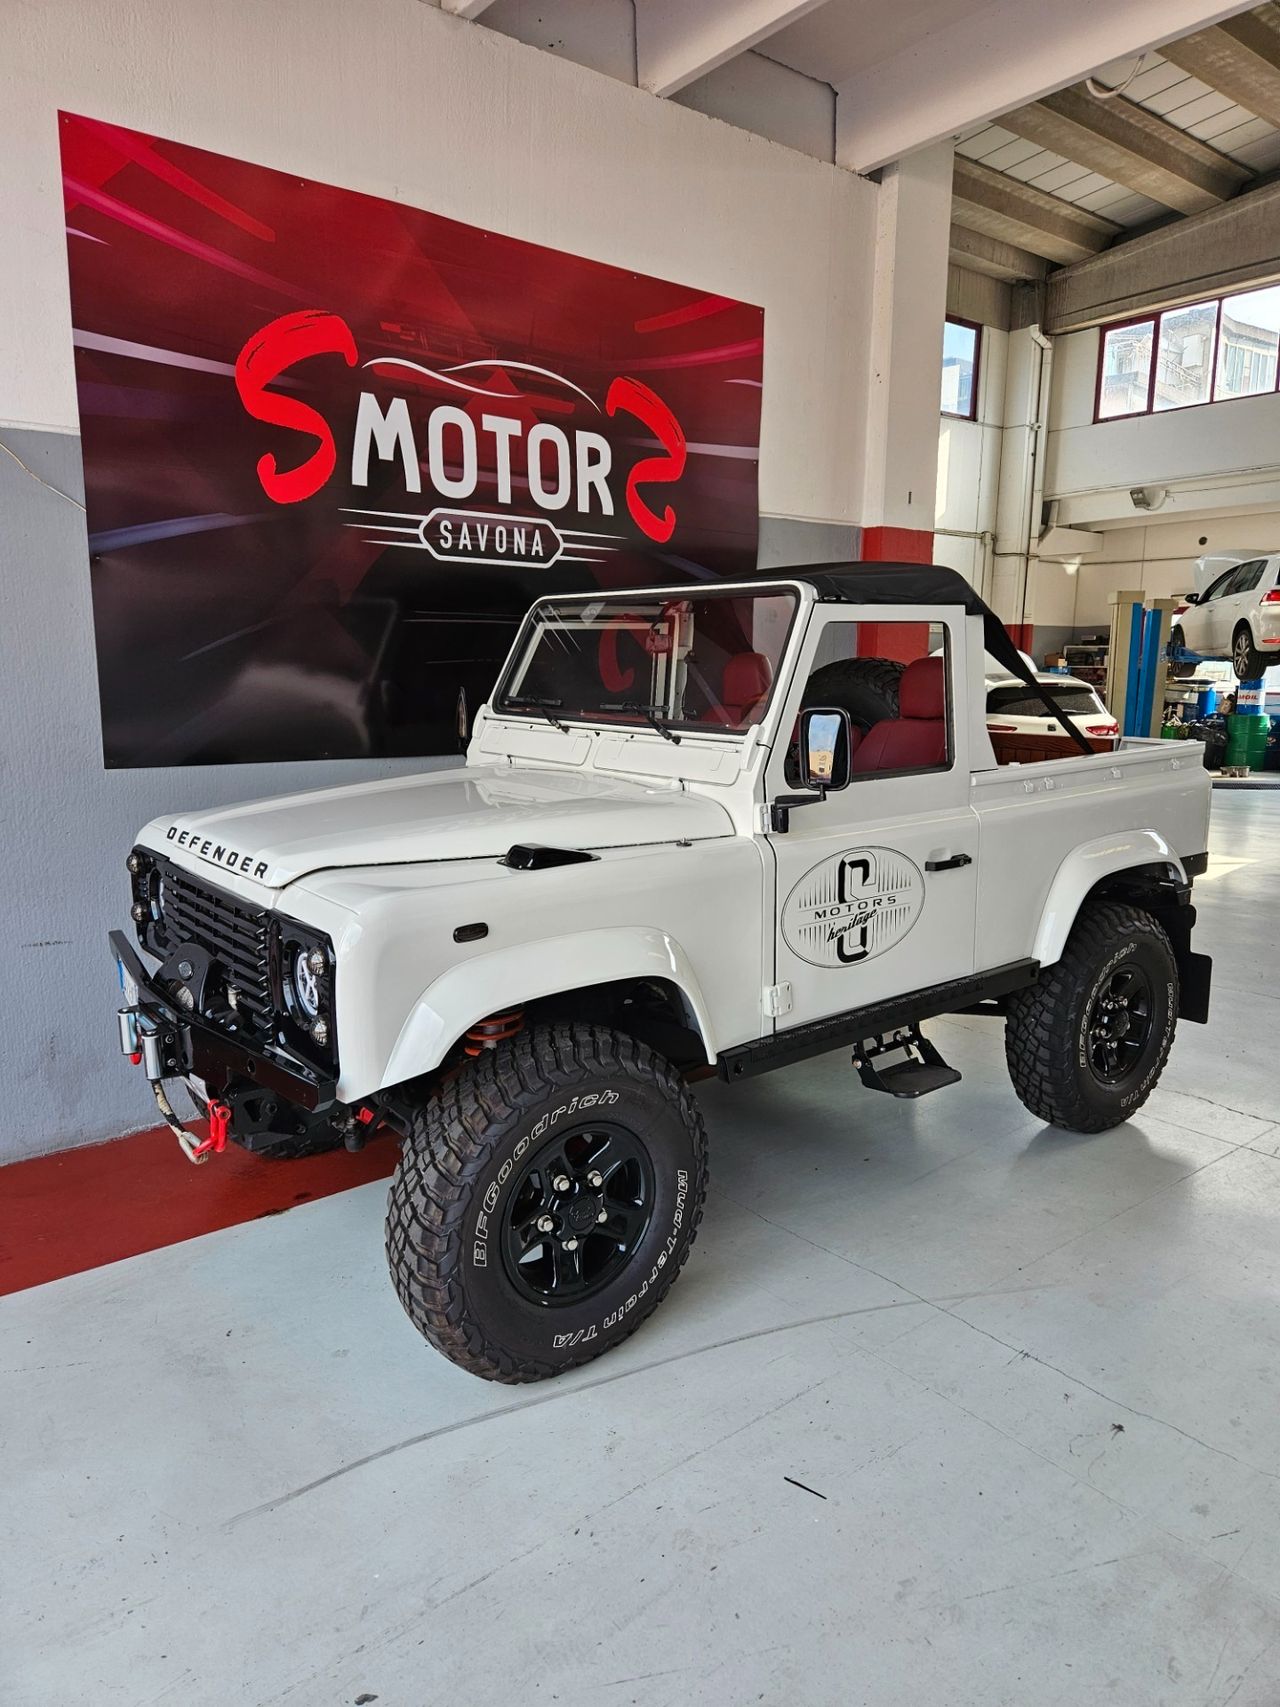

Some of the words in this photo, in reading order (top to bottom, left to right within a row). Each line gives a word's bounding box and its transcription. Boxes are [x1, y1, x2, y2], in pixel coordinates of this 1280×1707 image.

[439, 519, 545, 557] SAVONA
[166, 826, 269, 879] DEFENDER
[814, 895, 897, 920] MOTORS
[826, 908, 878, 943] heritage
[473, 1089, 620, 1267] BFGoodrich
[603, 1169, 688, 1329] Mud-Terrain
[552, 1323, 597, 1348] T/A
